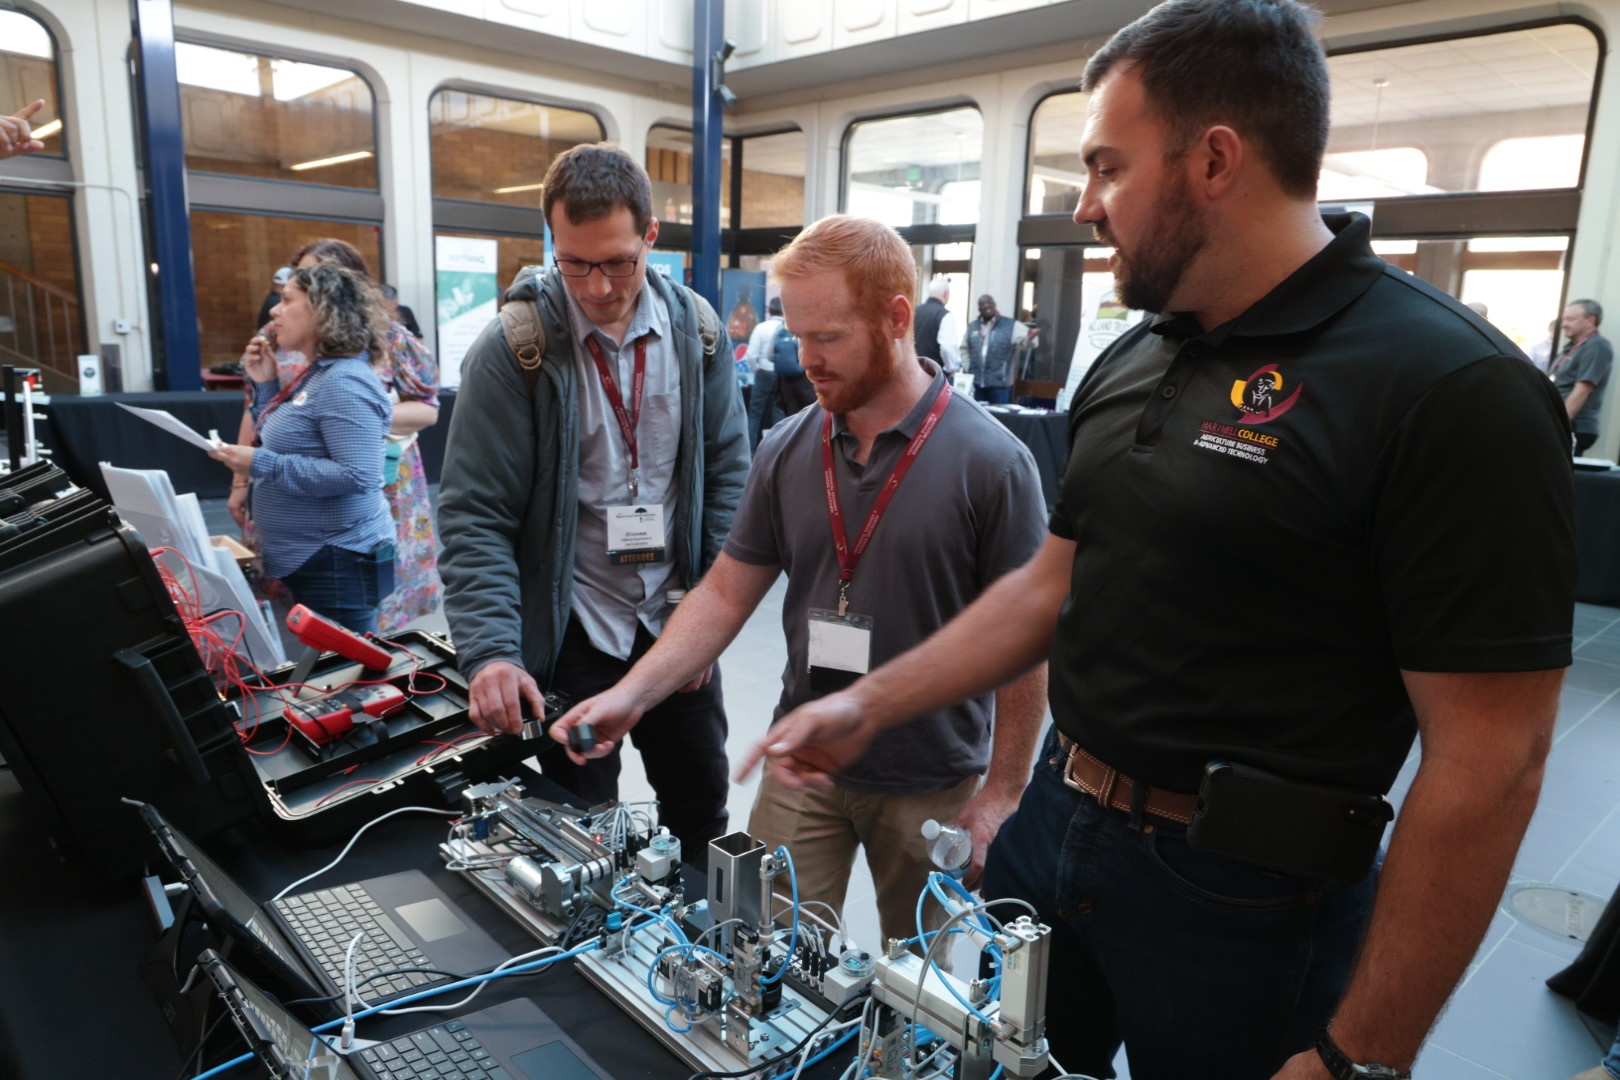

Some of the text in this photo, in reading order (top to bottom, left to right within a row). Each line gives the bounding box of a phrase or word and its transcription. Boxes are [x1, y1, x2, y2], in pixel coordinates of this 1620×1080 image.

[1200, 433, 1266, 455] AGRICULTURE BUSINESS
[1237, 429, 1279, 448] COLLEGE
[1198, 441, 1227, 453] ADVANCED
[1227, 447, 1269, 464] TECHNOLOGY
